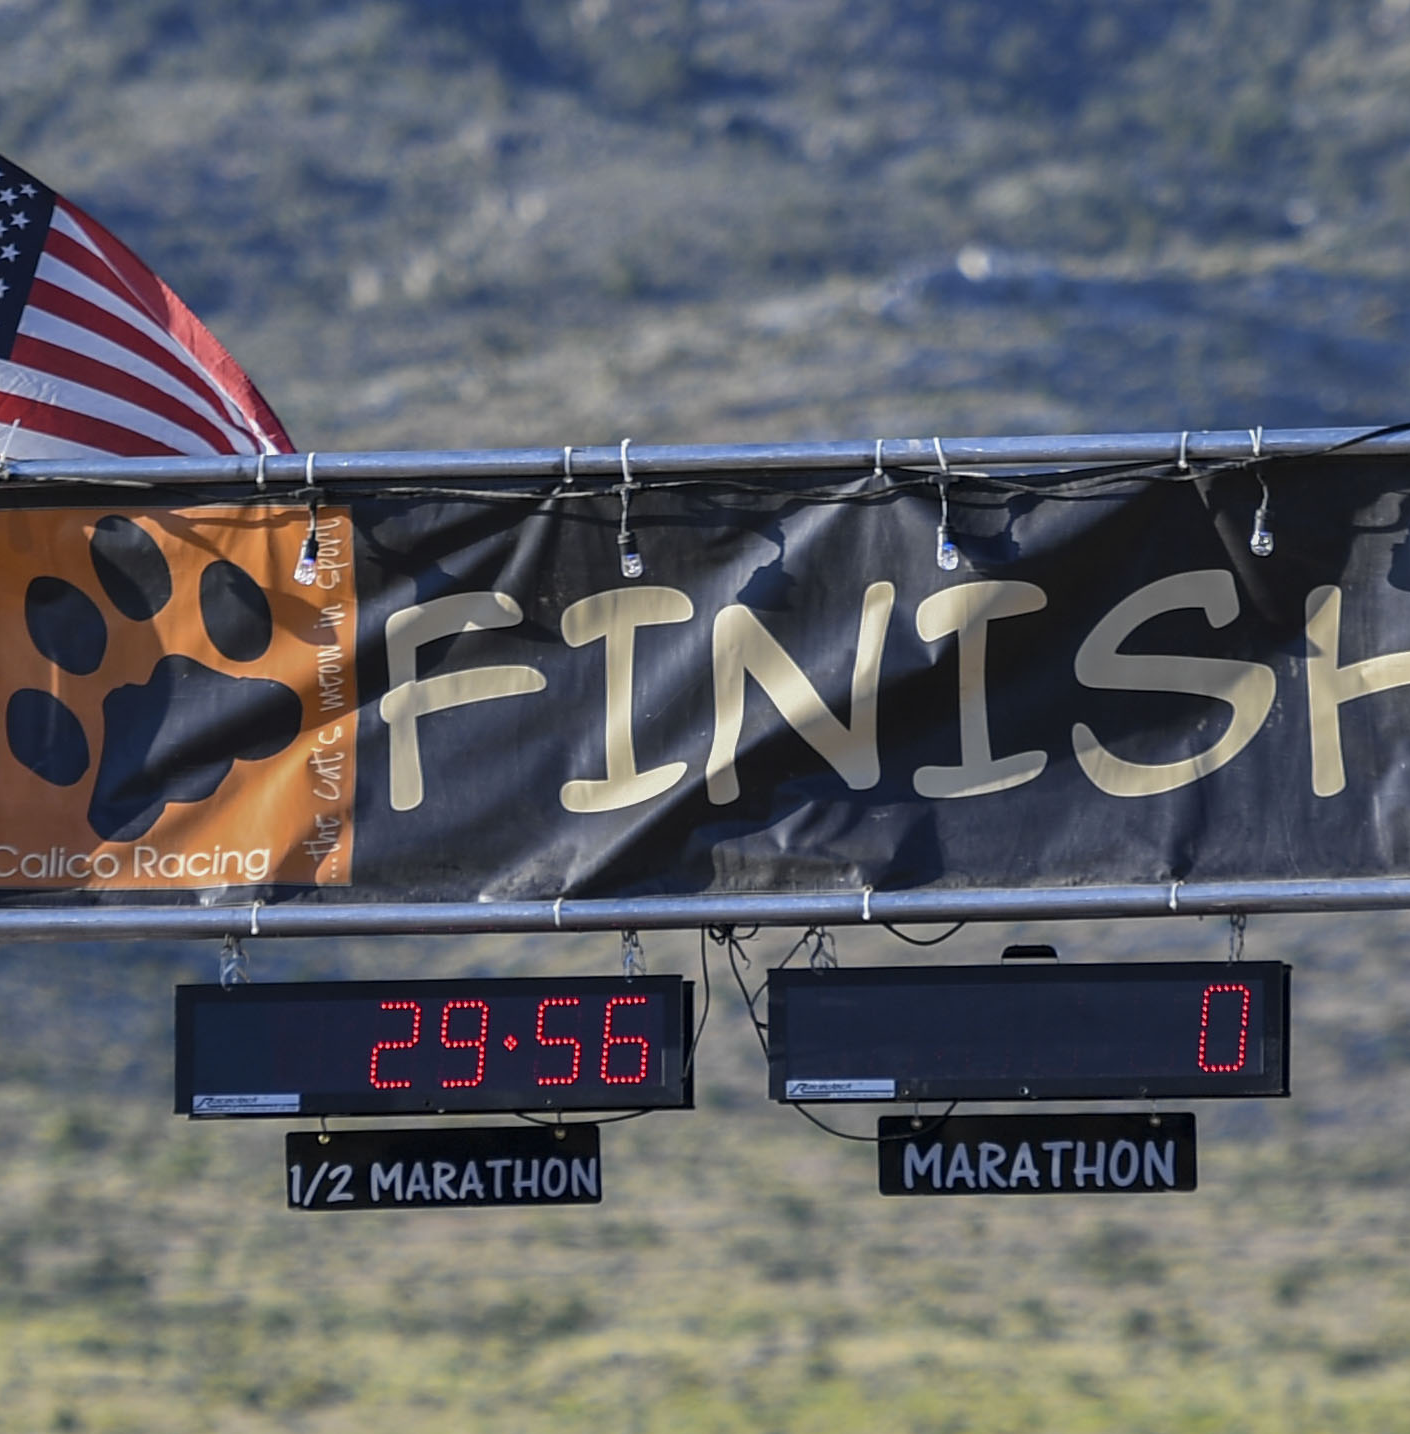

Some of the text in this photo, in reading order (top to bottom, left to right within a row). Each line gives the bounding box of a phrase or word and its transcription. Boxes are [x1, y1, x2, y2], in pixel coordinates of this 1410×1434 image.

[313, 603, 346, 628] in
[316, 644, 345, 712] meow
[309, 725, 345, 800] cat's
[132, 844, 271, 881] Racing
[1198, 982, 1250, 1073] 0
[290, 1157, 597, 1207] 1/2 MARATHON
[903, 1139, 1175, 1189] MARATHON
